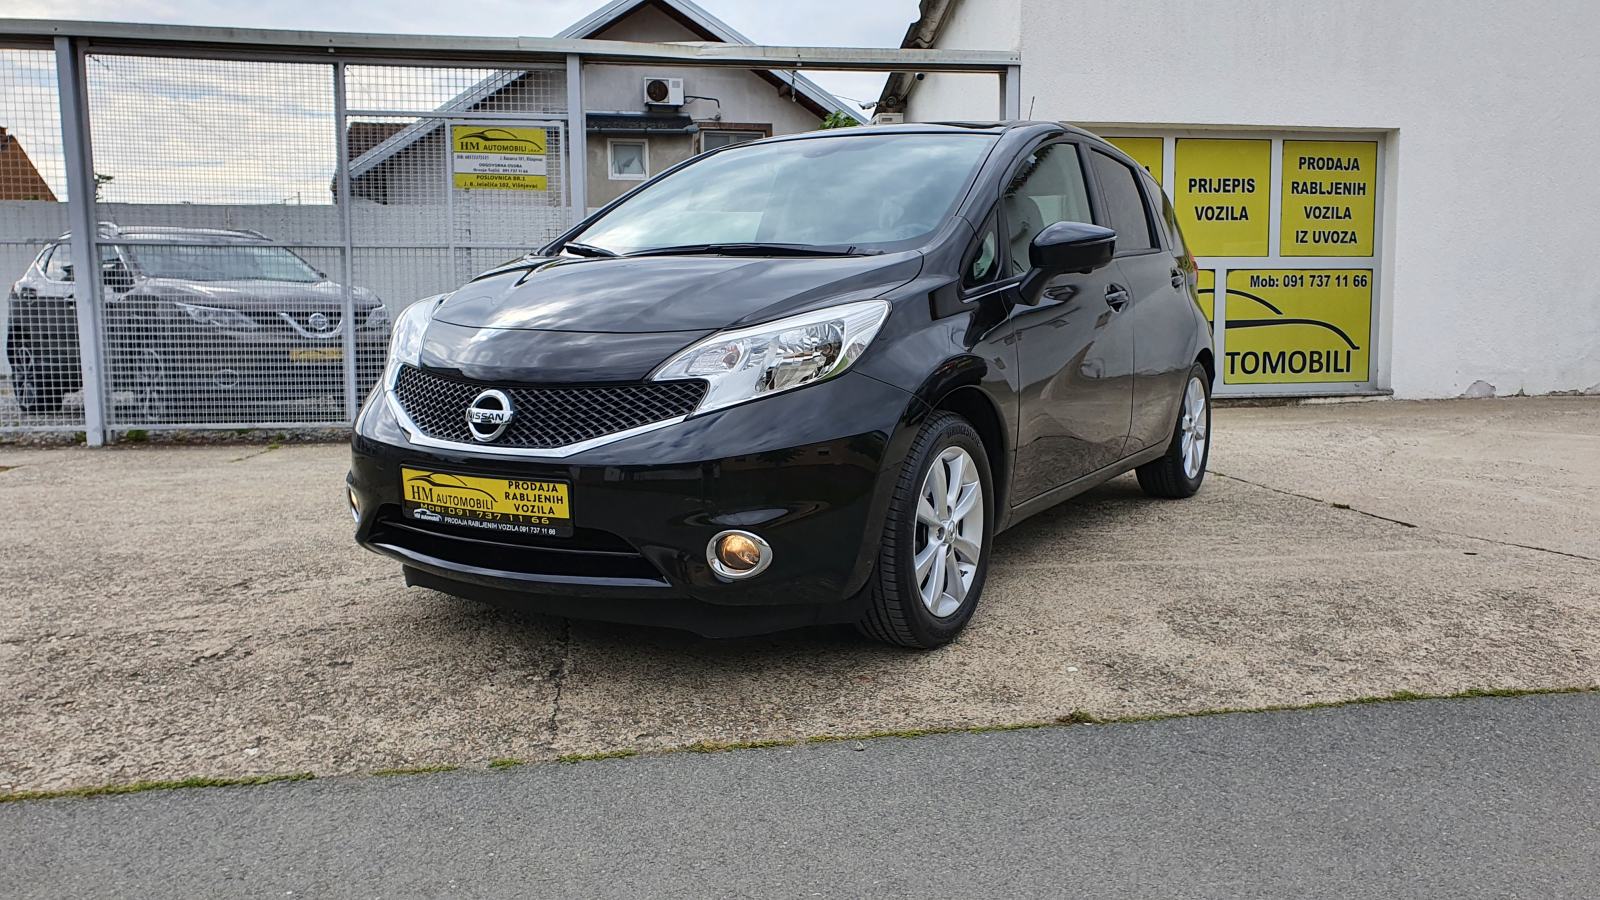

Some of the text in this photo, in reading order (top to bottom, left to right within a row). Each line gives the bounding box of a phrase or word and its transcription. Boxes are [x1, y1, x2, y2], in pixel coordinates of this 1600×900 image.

[460, 142, 479, 150] HM
[1298, 156, 1360, 171] PRODAJA
[1188, 177, 1256, 193] PRIJEPIS
[1291, 181, 1366, 196] RABLJENIH
[1194, 206, 1249, 221] VOZILA
[1303, 206, 1352, 220] VOZILA
[1295, 230, 1358, 244] IZ UVOZA
[1250, 274, 1368, 288] Mob: 091 737 11 66
[1225, 350, 1351, 375] TOMOBILI
[468, 411, 504, 421] NISSAN
[507, 480, 559, 493] PRODAJA
[411, 485, 494, 511] HM AUTOMOBILI
[504, 492, 564, 505] RABLJENIH
[448, 507, 471, 517] 091
[476, 511, 501, 520] 737
[509, 514, 523, 523] 11
[531, 516, 550, 525] 66
[513, 503, 556, 515] VOZILA
[444, 516, 467, 526] PRODAJA
[467, 519, 498, 530] RABLJENIH
[498, 523, 519, 532] VOZILA
[519, 525, 529, 533] 091
